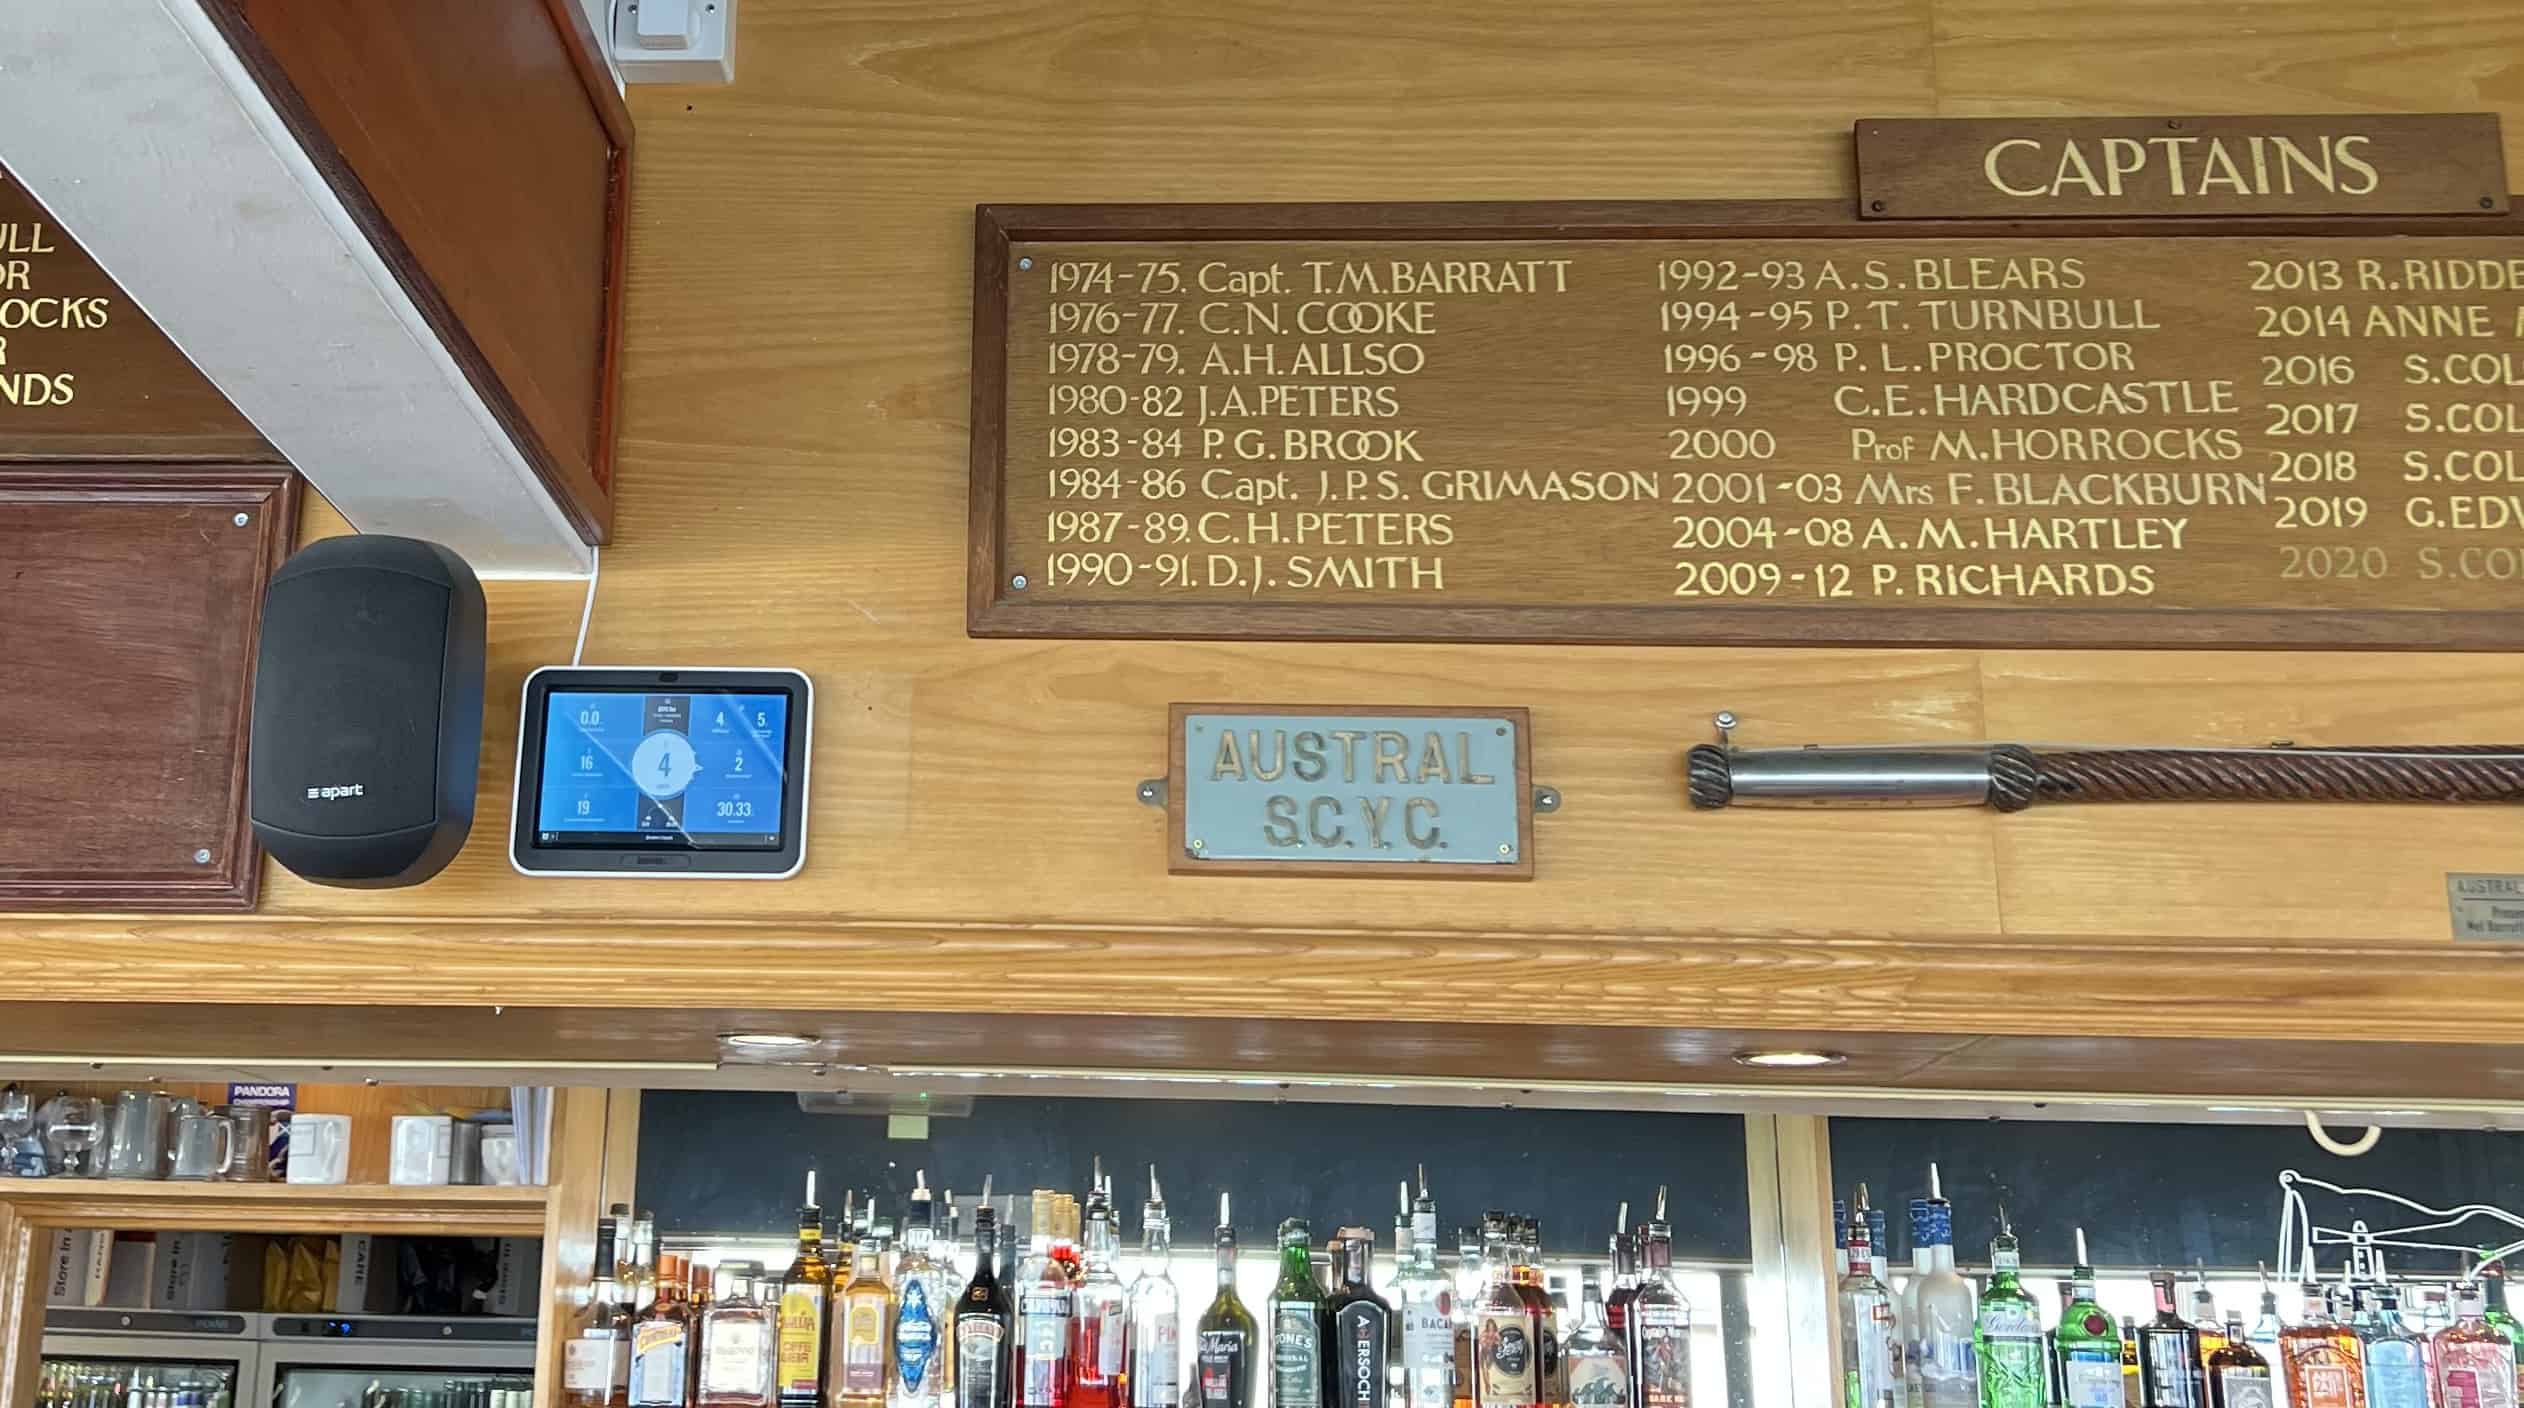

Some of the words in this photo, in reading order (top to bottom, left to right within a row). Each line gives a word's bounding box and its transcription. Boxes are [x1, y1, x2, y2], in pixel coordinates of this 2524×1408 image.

[1983, 134, 2379, 198] CAPTAINS
[1197, 261, 1292, 298] Capt.
[1657, 259, 1806, 292] 1992-93
[2247, 259, 2344, 292] 2013
[1296, 301, 1437, 335] COOKE
[1660, 300, 1813, 332] 1994-95
[2254, 304, 2351, 338] 2014
[2363, 304, 2496, 338] ANNE
[1663, 342, 1818, 374] 1996-98
[2260, 354, 2355, 387] 2016
[1048, 383, 1185, 417] 1980-82
[1666, 385, 1747, 417] 1999
[2263, 402, 2359, 436] 2017
[1048, 426, 1183, 460] 1983-84
[1668, 428, 1777, 460] 2000
[1851, 428, 1915, 462] Prof
[2269, 450, 2358, 483] 2018
[1048, 467, 1187, 500] 1984-86
[1200, 468, 1299, 506] Capt.
[1421, 469, 1660, 502] GRIMASON
[1671, 472, 1843, 505] 2001-03
[1854, 472, 1935, 505] Mrs
[2273, 495, 2368, 529] 2019
[1671, 515, 1854, 550] 2004-08
[1287, 555, 1444, 590] SMITH
[2280, 546, 2388, 579] 2020
[1673, 561, 1854, 598] 2009-12
[715, 712, 725, 726] 4
[756, 712, 766, 727] 5
[580, 755, 594, 770] 16
[657, 752, 672, 777] 4
[734, 756, 744, 772] 2
[1209, 729, 1496, 785] AUSTRAL
[320, 783, 364, 801] apart
[577, 800, 591, 815] 19
[233, 1085, 290, 1097] PANDORA
